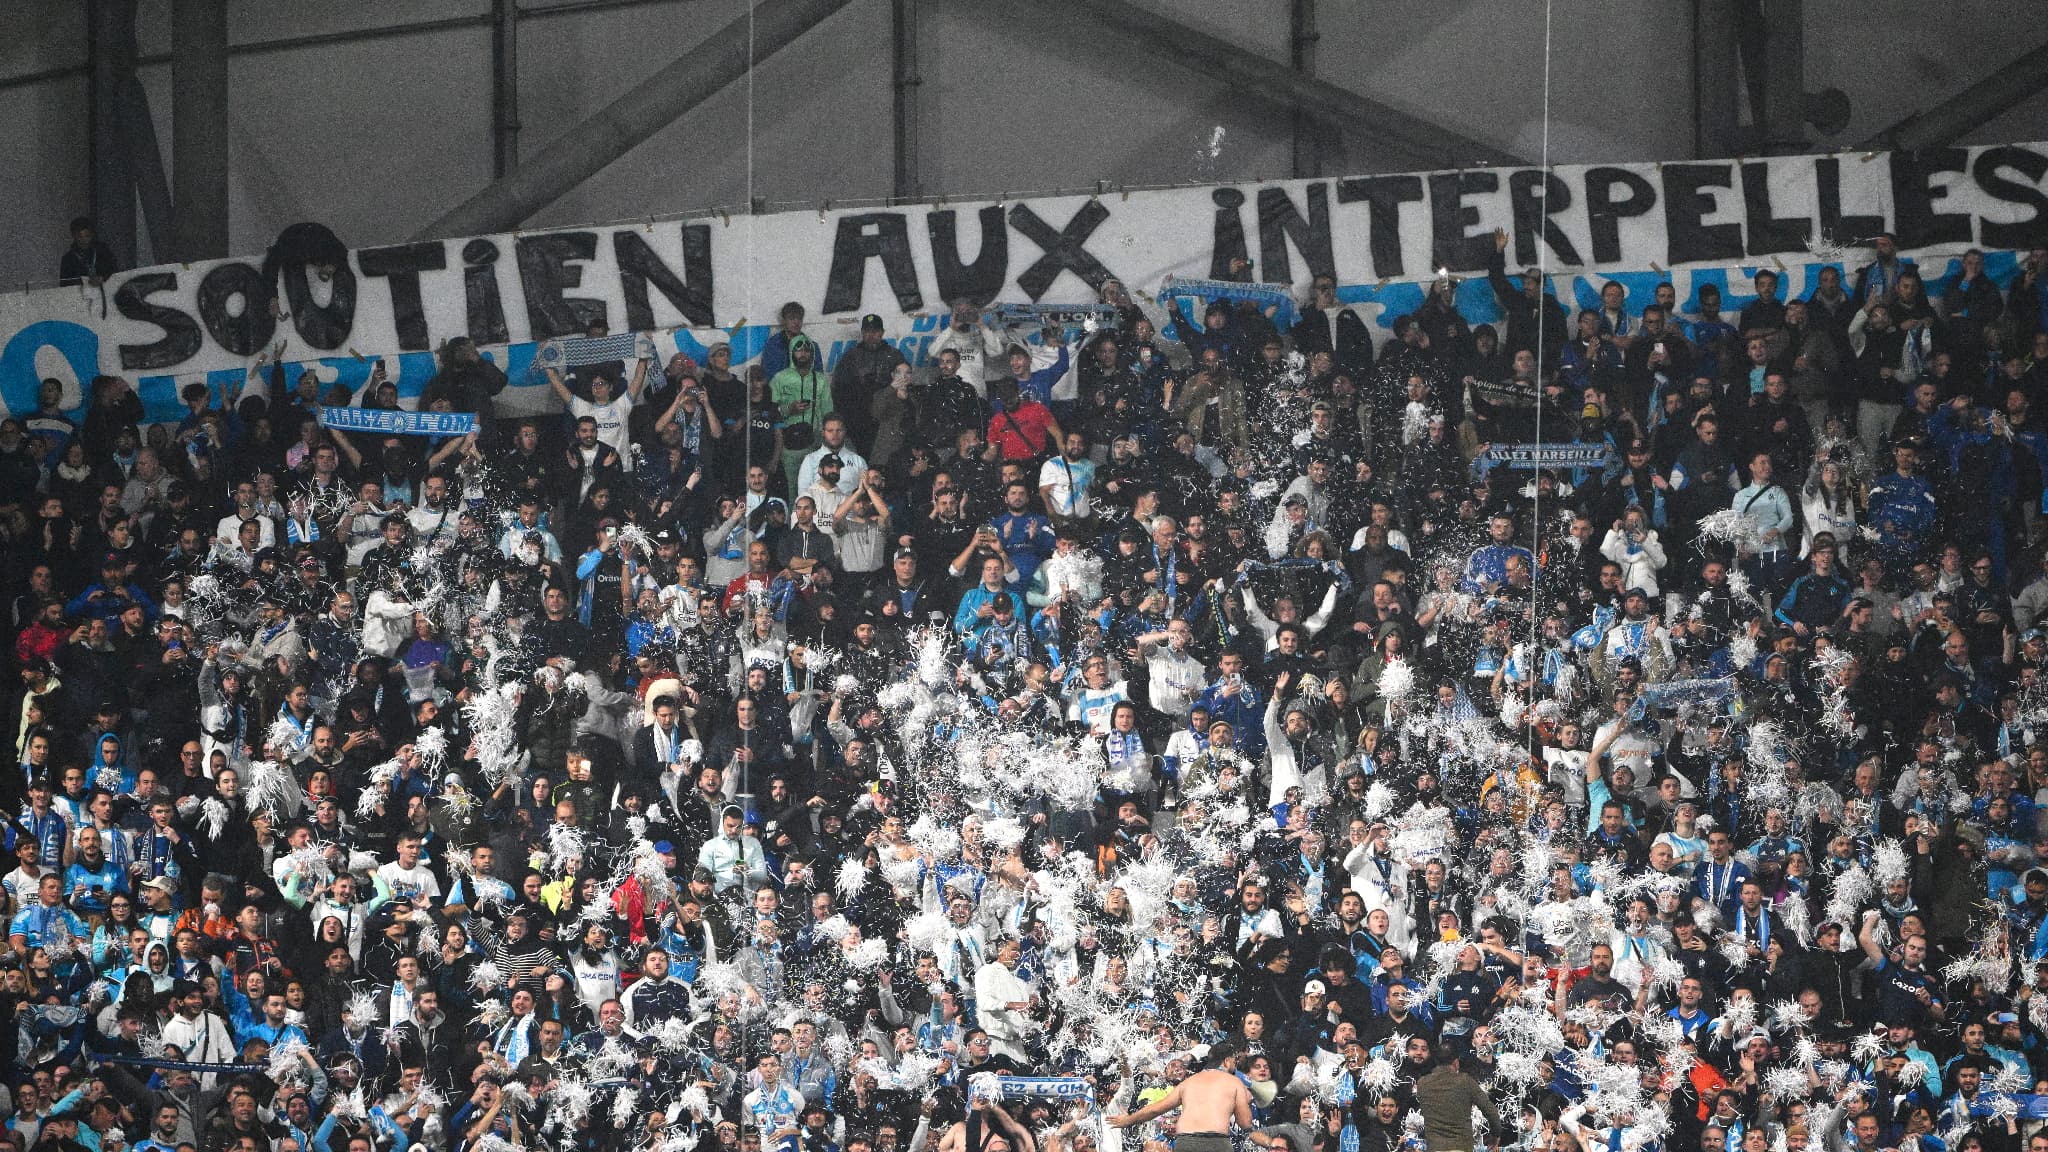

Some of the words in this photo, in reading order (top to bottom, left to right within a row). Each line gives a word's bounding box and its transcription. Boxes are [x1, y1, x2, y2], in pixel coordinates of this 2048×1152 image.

[822, 200, 1122, 315] AUX
[1490, 450, 1529, 460] ALLEZ
[1531, 450, 1602, 460] MARSEILLE
[597, 574, 622, 583] Oran
